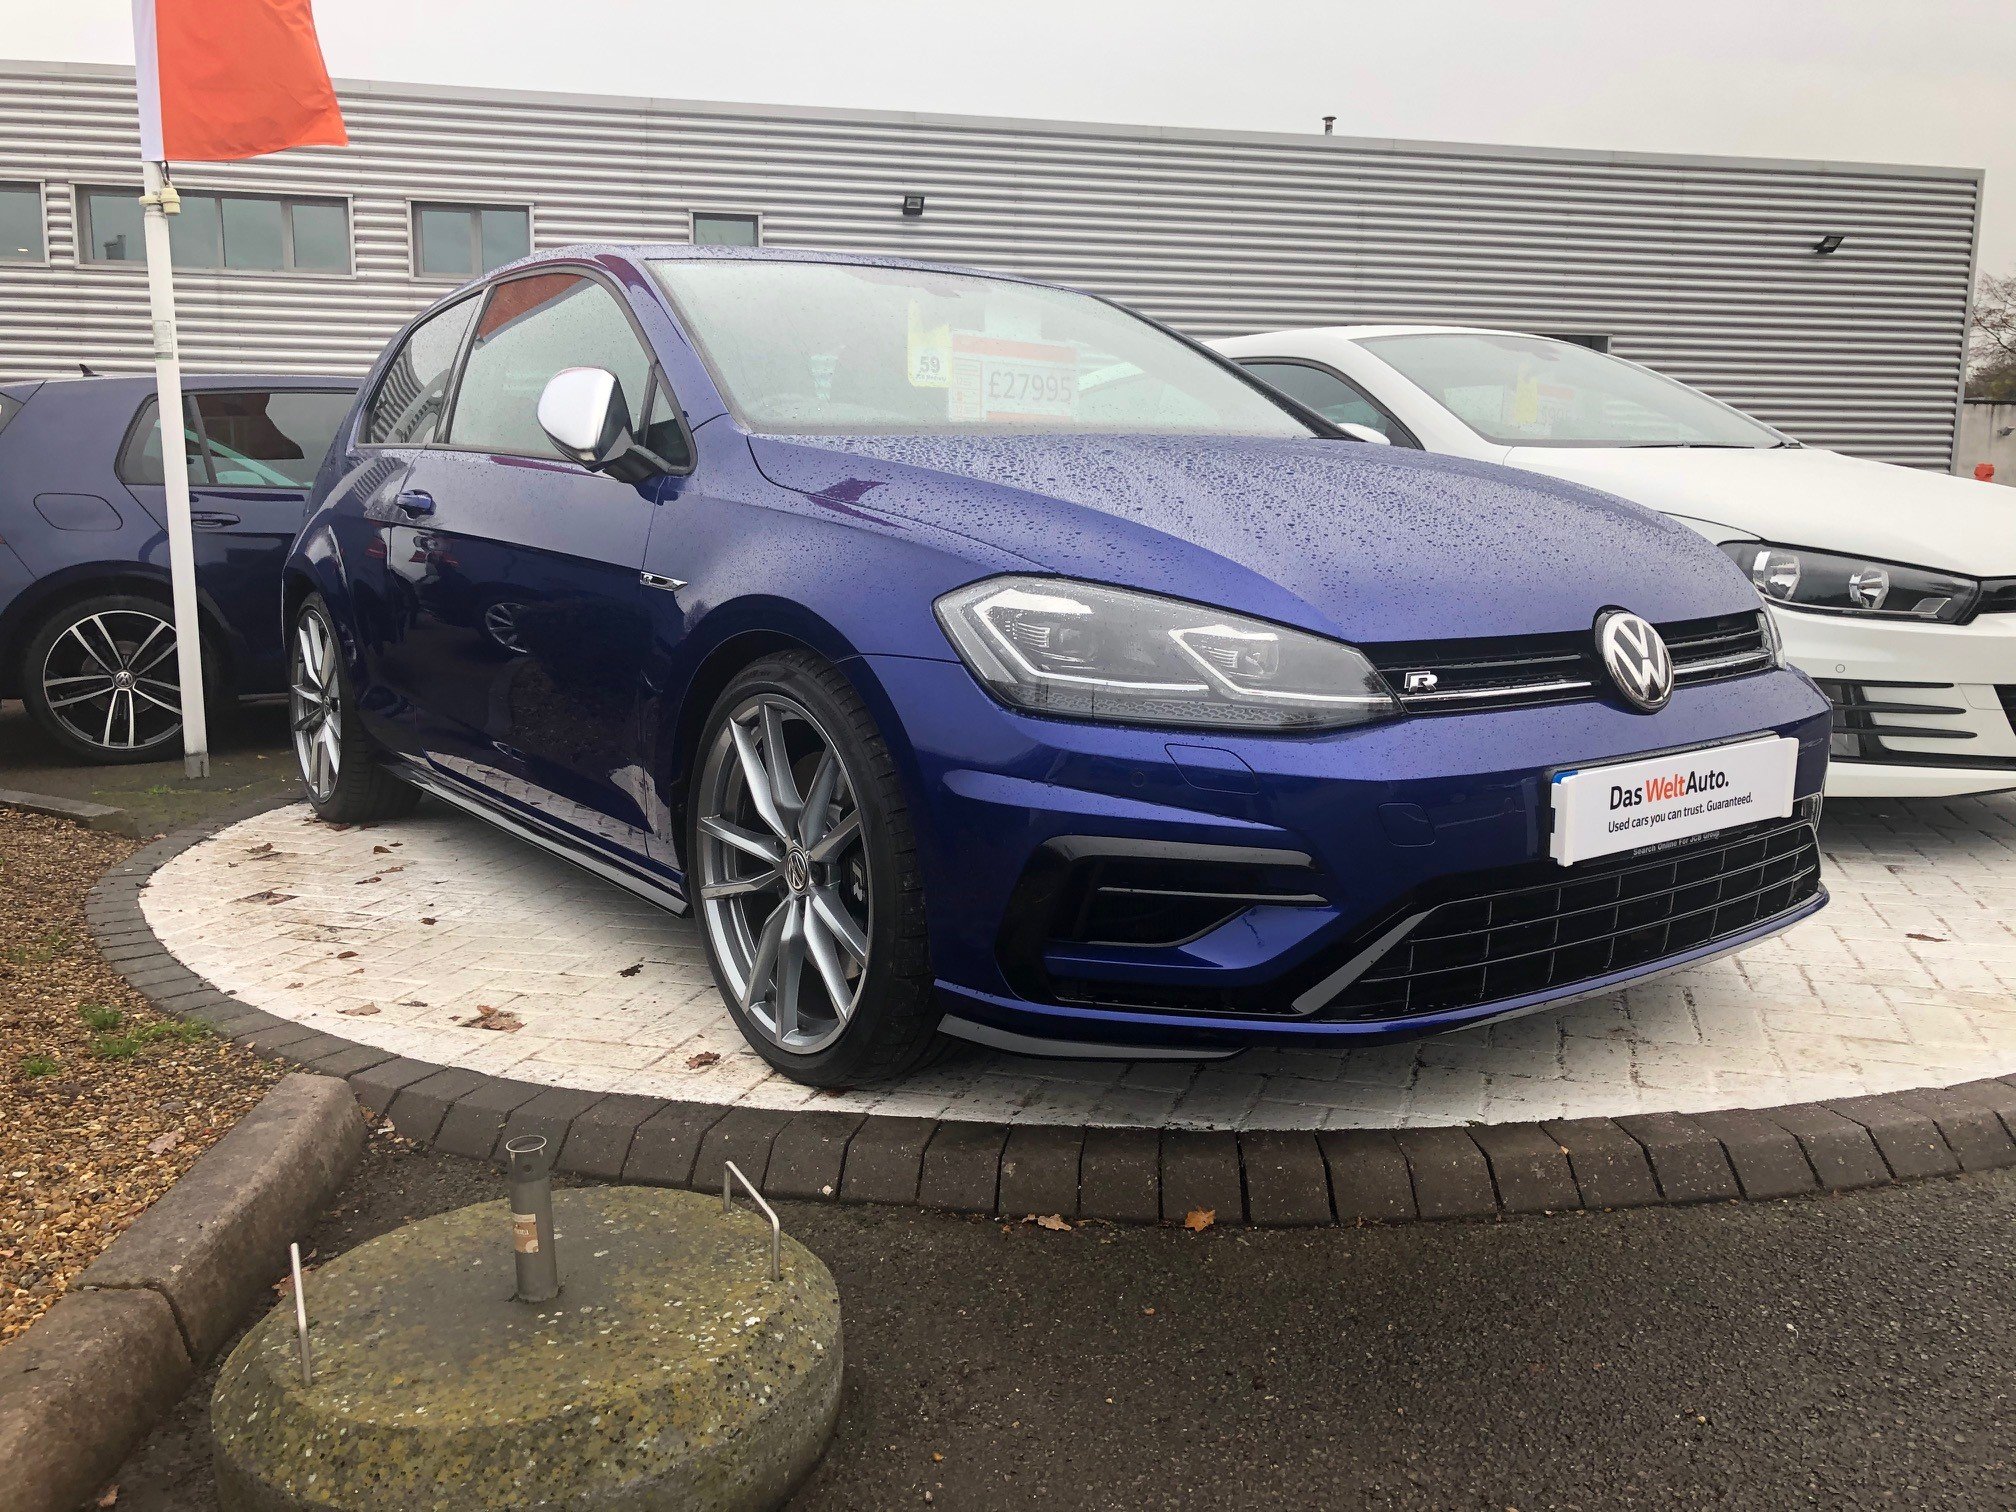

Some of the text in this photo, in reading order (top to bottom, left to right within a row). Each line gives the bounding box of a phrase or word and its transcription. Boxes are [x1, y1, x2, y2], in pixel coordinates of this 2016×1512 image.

[920, 355, 941, 373] 59
[988, 371, 1072, 402] £27995
[1404, 670, 1438, 692] R
[1609, 785, 1643, 811] Das
[1608, 792, 1753, 834] Used cars you can trust. Guaranteed.
[1633, 844, 1656, 856] Search
